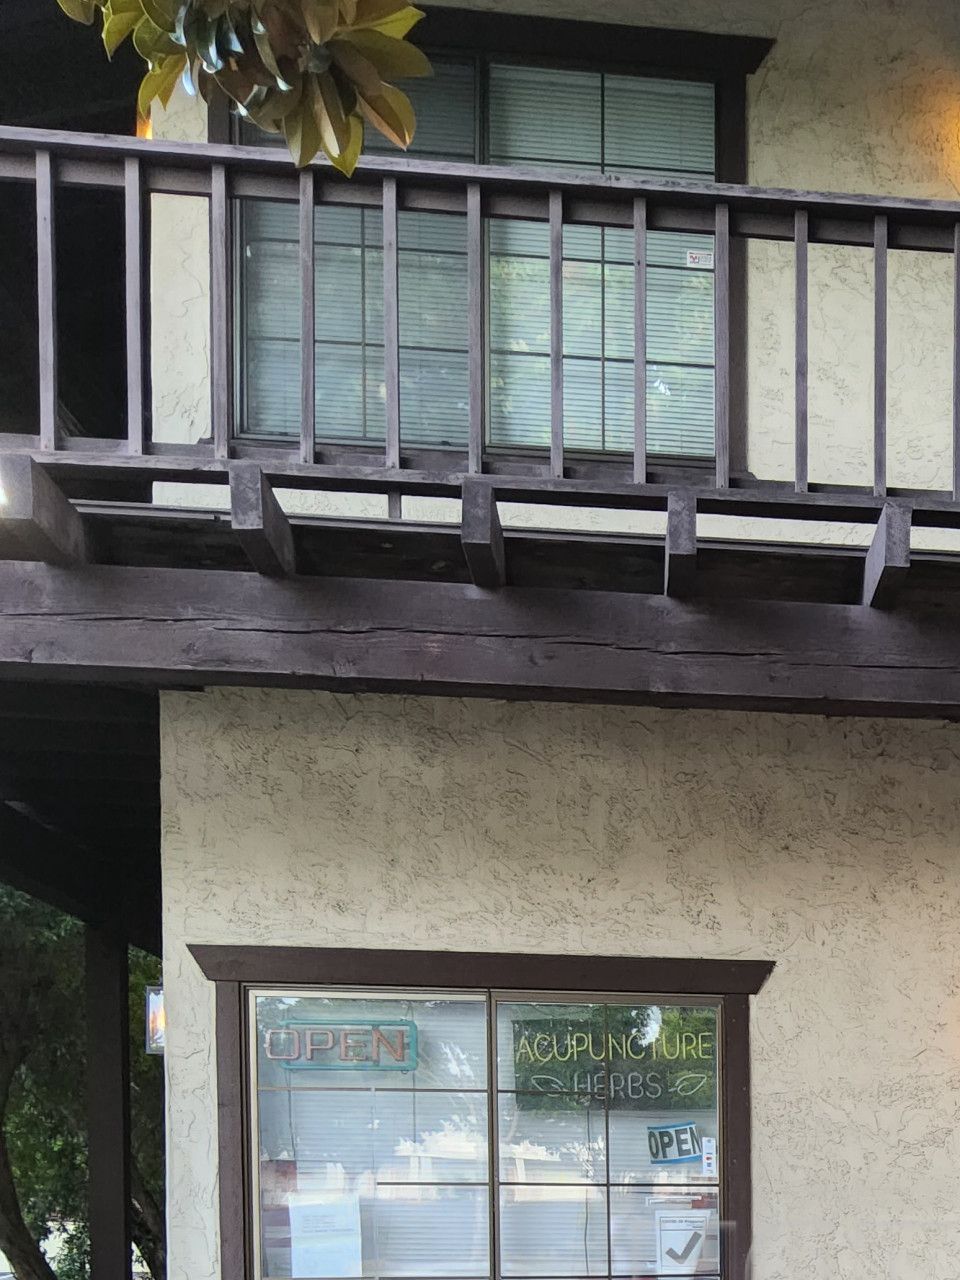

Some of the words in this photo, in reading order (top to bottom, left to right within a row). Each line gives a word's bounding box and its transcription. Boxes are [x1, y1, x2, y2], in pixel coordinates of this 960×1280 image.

[264, 1028, 405, 1062] OPEN
[516, 1033, 713, 1064] ACUPUNCTURE
[574, 1072, 662, 1099] HERBS
[648, 1126, 703, 1159] OPEN
